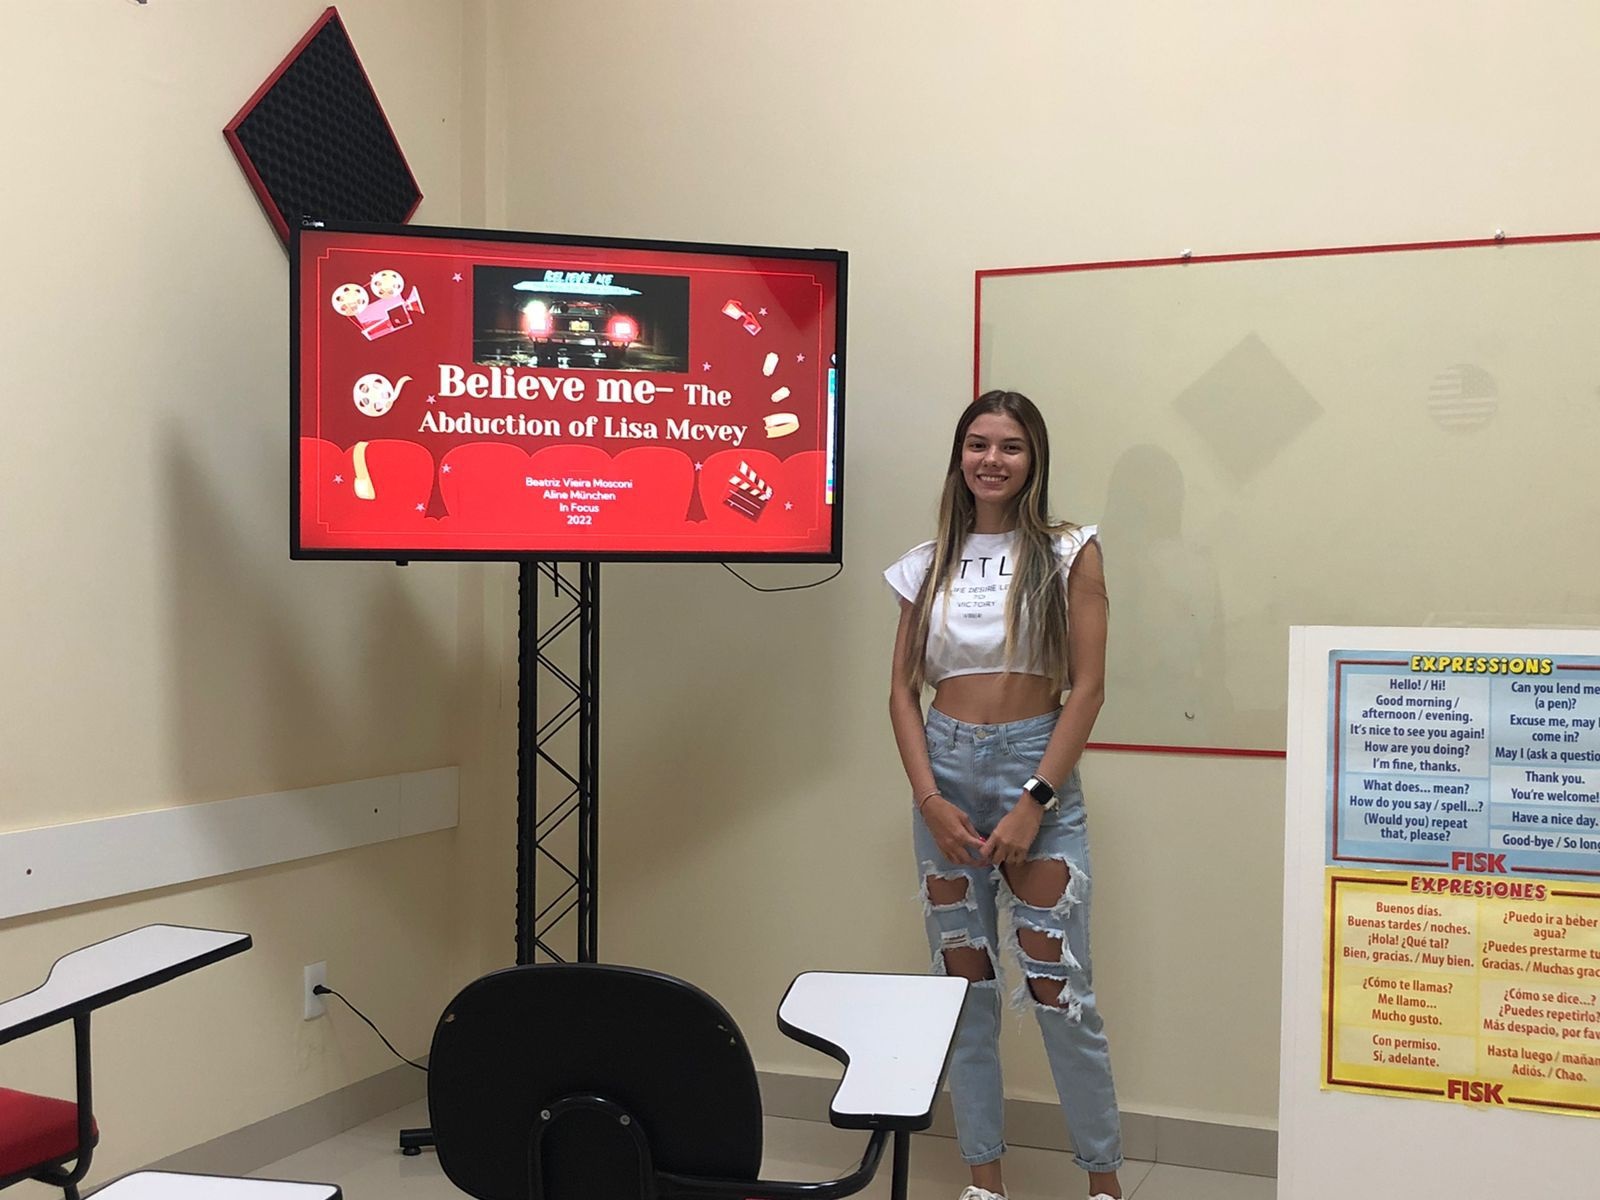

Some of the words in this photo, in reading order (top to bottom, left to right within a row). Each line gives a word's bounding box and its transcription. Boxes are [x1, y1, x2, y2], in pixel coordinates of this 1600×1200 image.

[544, 270, 591, 284] BELIEVE
[594, 273, 614, 286] ME
[438, 364, 585, 401] Believe
[684, 384, 732, 406] The
[418, 410, 561, 437] Abduction
[568, 415, 599, 437] of
[604, 416, 658, 439] Lisa
[666, 418, 748, 446] Mcvey
[525, 476, 561, 487] Beatriz
[562, 477, 592, 488] Vieira
[593, 478, 633, 488] Mosconi
[543, 489, 568, 499] Aline
[570, 490, 616, 500] München
[559, 502, 569, 512] In
[571, 502, 600, 513] Focus
[567, 515, 592, 525] 2022
[1389, 678, 1421, 690] Hello!
[1430, 680, 1446, 691] Hi!
[1511, 681, 1531, 693] Can
[1534, 684, 1553, 696] you
[1556, 682, 1580, 694] lend
[1583, 686, 1600, 695] me
[1376, 695, 1403, 706] Good
[1406, 696, 1452, 710] morning
[1535, 697, 1545, 710] (a
[1547, 698, 1577, 711] pen)?
[1362, 708, 1416, 720] afternoon
[1425, 711, 1473, 724] evening.
[1510, 714, 1546, 726] Excuse
[1548, 717, 1569, 728] me,
[1572, 718, 1595, 730] may
[1350, 724, 1366, 735] It's
[1369, 725, 1391, 736] nice
[1393, 726, 1405, 736] to
[1407, 728, 1425, 737] see
[1428, 729, 1447, 740] you
[1450, 728, 1485, 741] again!
[1532, 732, 1561, 742] come
[1564, 731, 1579, 743] in?
[1364, 741, 1388, 752] How
[1390, 744, 1408, 753] are
[1411, 746, 1430, 756] you
[1433, 744, 1470, 758] doing?
[1495, 747, 1517, 761] May
[1527, 748, 1548, 760] (ask
[1551, 752, 1557, 760] a
[1373, 758, 1390, 769] I'm
[1392, 759, 1417, 772] fine,
[1420, 760, 1461, 772] thanks.
[1525, 771, 1559, 783] Thank
[1562, 775, 1585, 786] you.
[1363, 779, 1392, 791] What
[1395, 780, 1430, 793] does...
[1433, 783, 1470, 795] mean?
[1511, 788, 1544, 800] You're
[1547, 790, 1600, 803] welcome!
[1350, 795, 1373, 807] How
[1376, 796, 1390, 808] do
[1392, 800, 1411, 811] you
[1414, 801, 1432, 812] say
[1441, 800, 1484, 813] spell...?
[1364, 812, 1402, 825] (Would
[1405, 815, 1429, 828] you)
[1431, 818, 1468, 830] repeat
[1512, 811, 1539, 823] Have
[1541, 815, 1548, 824] a
[1551, 813, 1573, 825] nice
[1576, 814, 1599, 829] day.
[1381, 827, 1407, 840] that,
[1410, 829, 1451, 841] please?
[1502, 834, 1554, 849] Good-bye
[1563, 837, 1577, 848] So
[1451, 851, 1507, 873] FISK
[1376, 902, 1414, 915] Buenos
[1347, 916, 1385, 928] Buenas
[1388, 919, 1421, 932] tardes
[1430, 923, 1471, 935] noches.
[1545, 913, 1554, 924] ir
[1556, 916, 1563, 926] a
[1533, 927, 1567, 941] agua?
[1429, 938, 1449, 949] tal?
[1343, 946, 1370, 961] Bien,
[1372, 950, 1413, 962] gracias.
[1422, 953, 1444, 967] Muy
[1447, 955, 1474, 967] bien.
[1529, 945, 1587, 959] prestarme
[1482, 957, 1524, 972] Gracias.
[1533, 962, 1574, 976] Muchas
[1576, 967, 1600, 979] grac
[1400, 980, 1410, 991] te
[1412, 980, 1453, 994] llamas?
[1378, 993, 1394, 1005] Me
[1396, 995, 1437, 1009] llamo...
[1542, 993, 1554, 1003] se
[1372, 1009, 1406, 1022] Mucho
[1409, 1013, 1442, 1026] gusto.
[1507, 1020, 1559, 1037] despacio,
[1562, 1028, 1581, 1040] por
[1372, 1034, 1392, 1047] Con
[1394, 1038, 1441, 1051] permiso.
[1388, 1053, 1440, 1067] adelante.
[1487, 1044, 1518, 1057] Hasta
[1521, 1048, 1553, 1064] luego
[1555, 1067, 1587, 1082] Chao.
[1447, 1079, 1504, 1104] FISK
